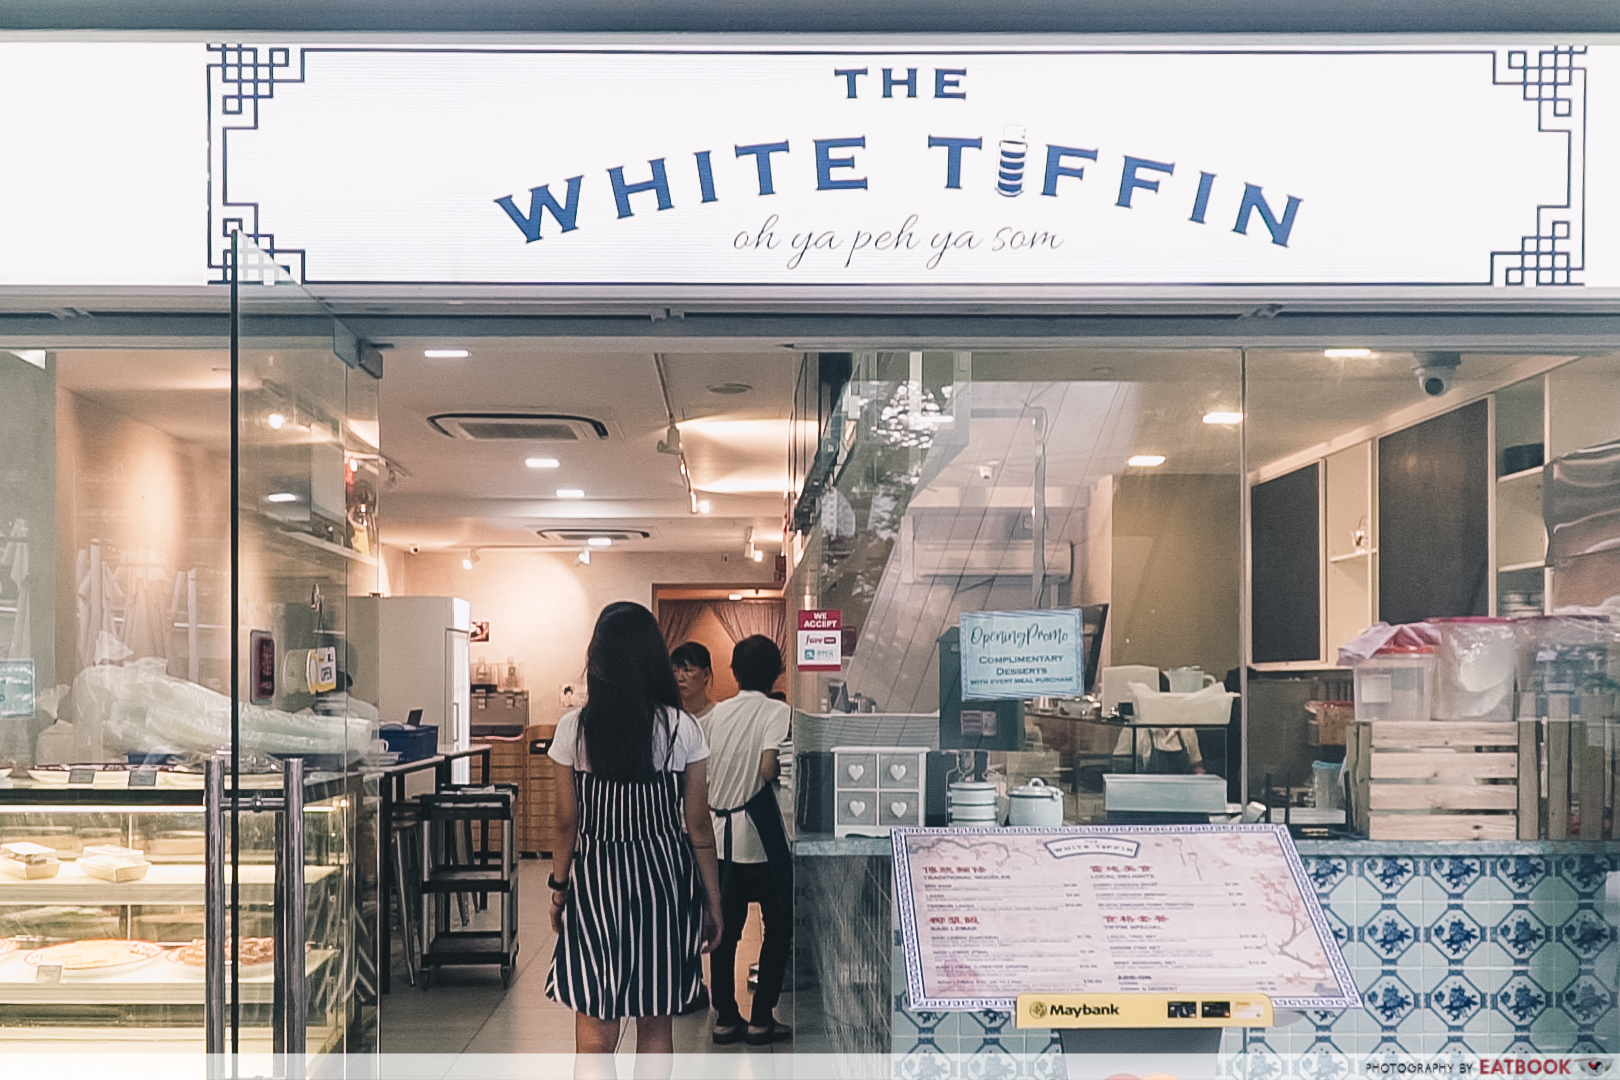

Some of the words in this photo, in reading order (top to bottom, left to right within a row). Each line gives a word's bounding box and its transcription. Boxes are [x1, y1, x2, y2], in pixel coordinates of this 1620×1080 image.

[834, 68, 967, 100] THE
[493, 136, 868, 245] WHITE
[733, 213, 782, 250] oh
[786, 230, 843, 270] ya
[844, 213, 922, 268] peh
[925, 230, 983, 270] ya
[990, 226, 1065, 252] som
[813, 611, 828, 620] WE
[803, 619, 838, 629] ACCEPT
[978, 654, 1064, 665] COMPLIMENTARY
[996, 667, 1047, 676] DESSERTS
[1049, 1003, 1119, 1018] Maybank
